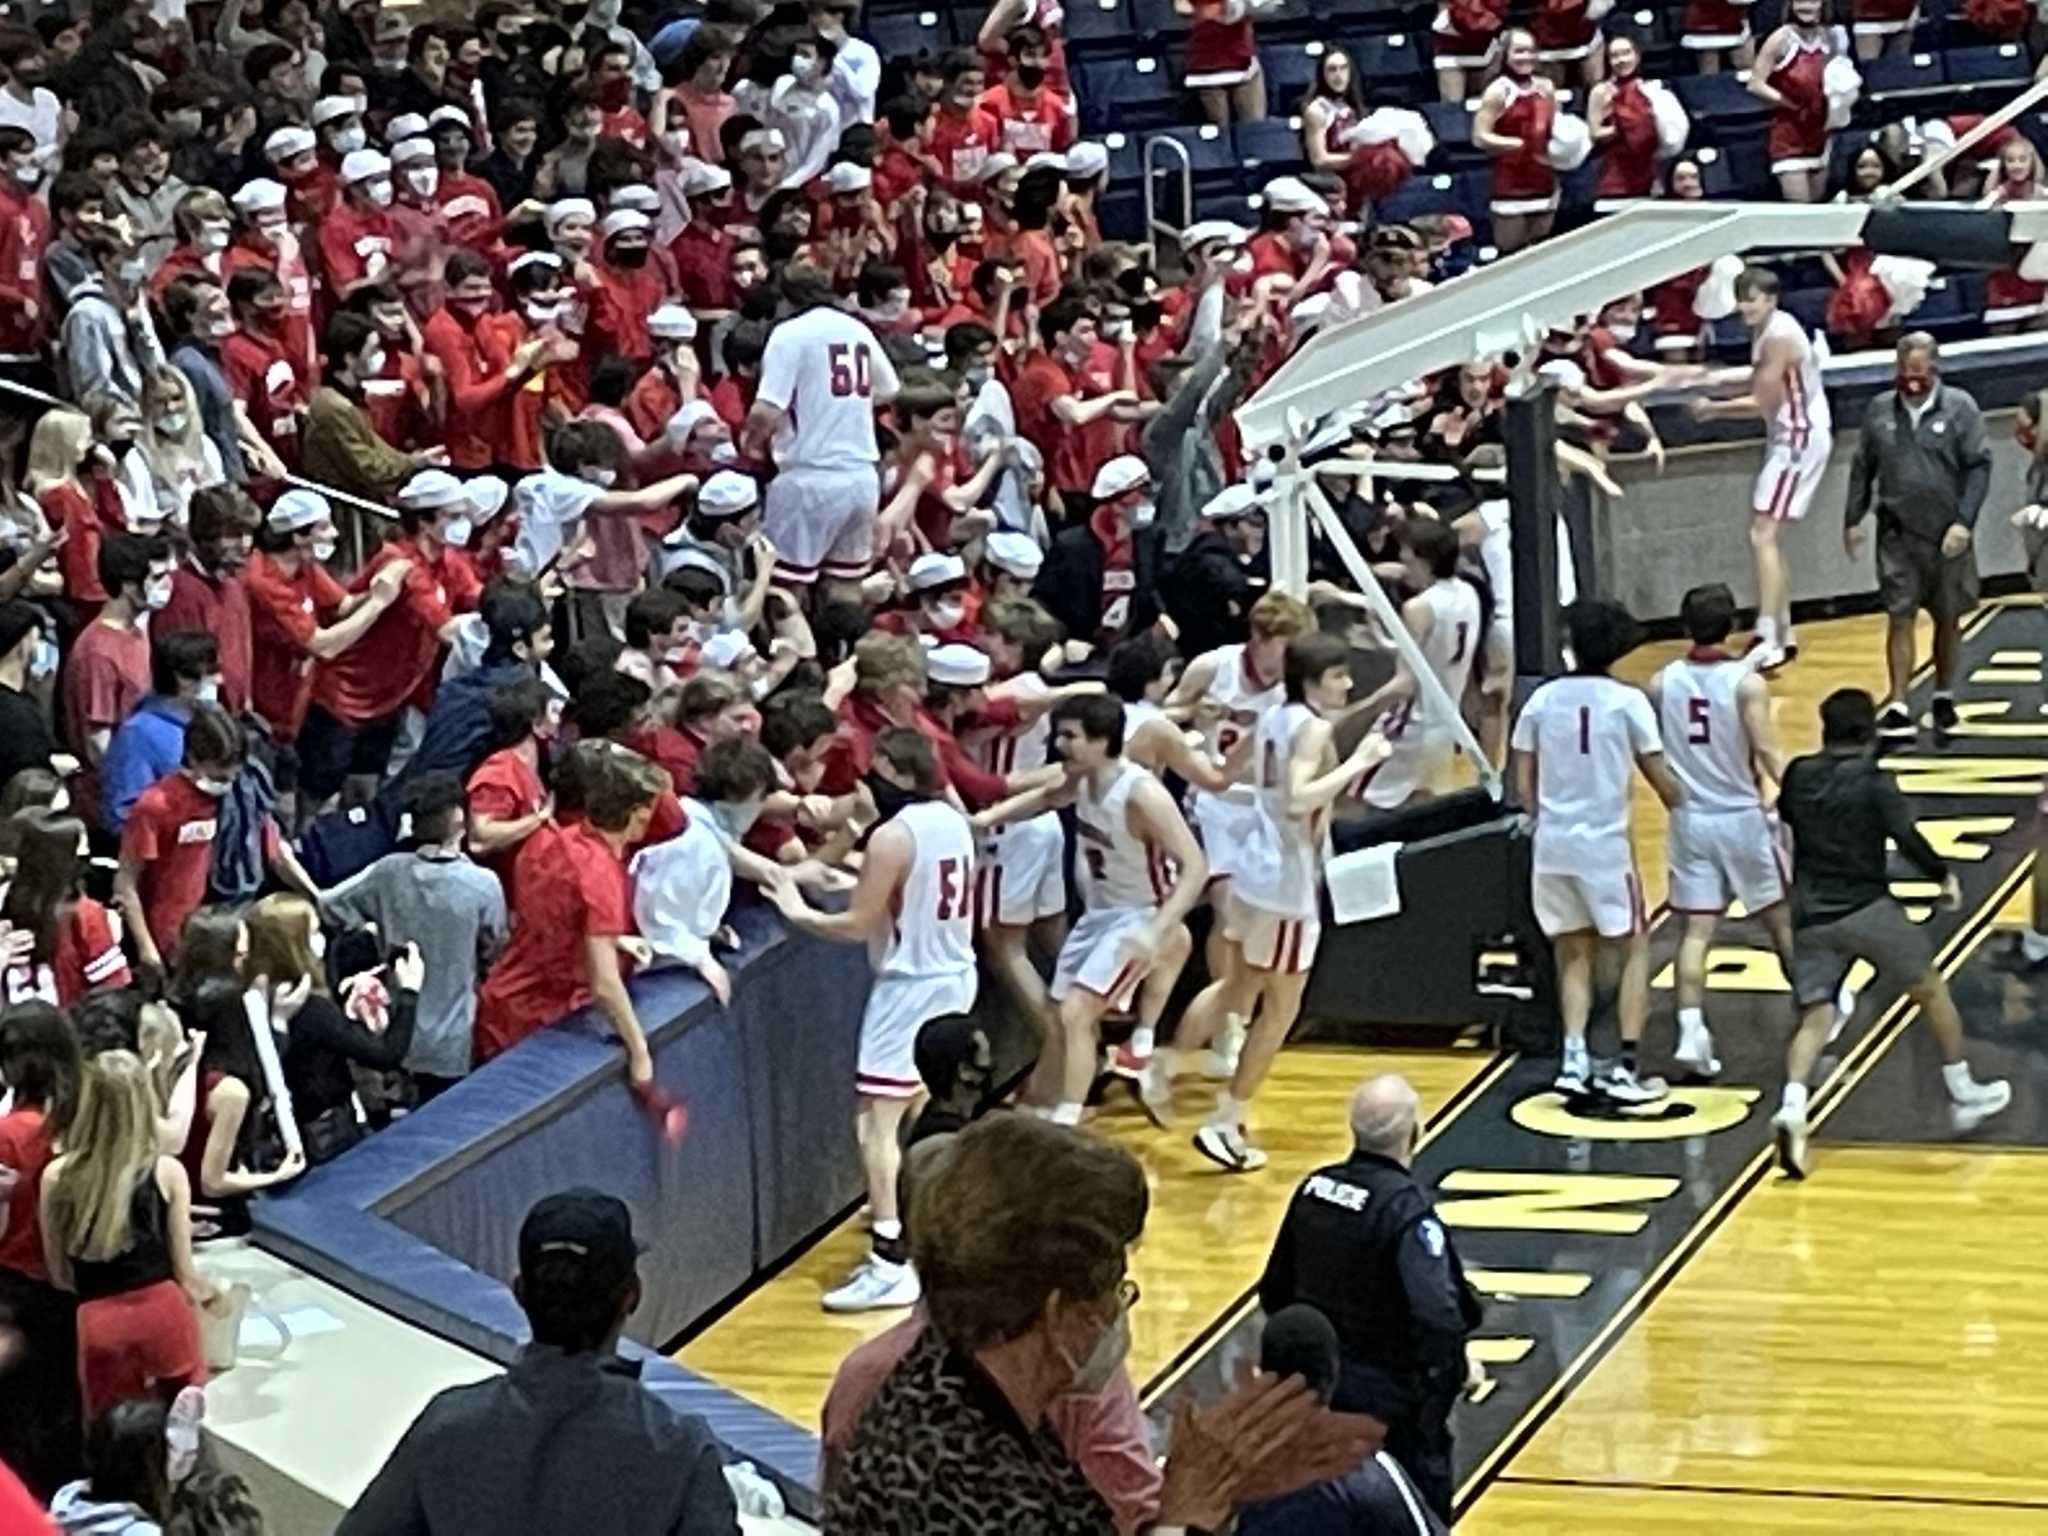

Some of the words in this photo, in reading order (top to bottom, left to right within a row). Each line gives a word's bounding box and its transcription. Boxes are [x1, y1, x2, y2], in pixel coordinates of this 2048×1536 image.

[1579, 705, 1590, 754] 1
[1688, 697, 1711, 745] 5
[1301, 1174, 1371, 1213] POLICE
